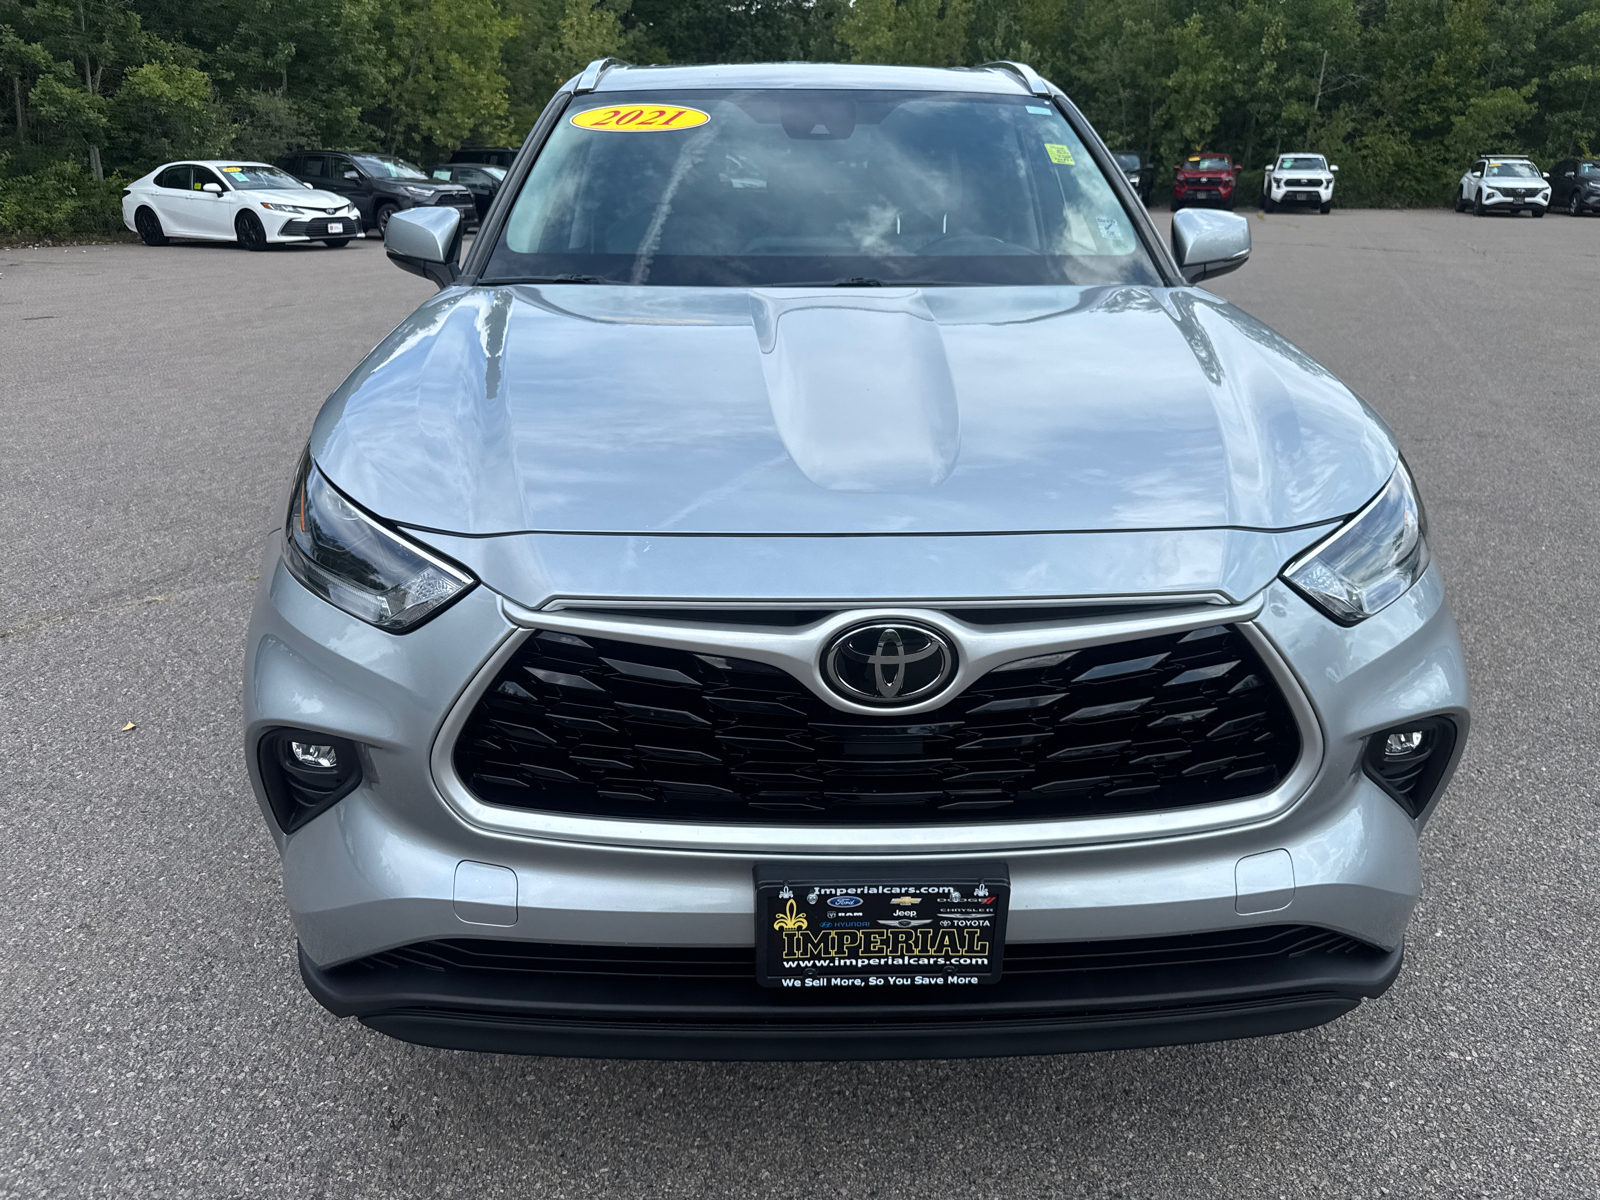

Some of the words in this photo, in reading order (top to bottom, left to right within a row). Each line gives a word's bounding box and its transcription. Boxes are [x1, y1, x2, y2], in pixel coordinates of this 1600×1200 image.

[590, 109, 687, 127] 2021
[813, 886, 954, 896] Imperialcars.com
[835, 898, 855, 906] Ford
[893, 909, 917, 918] Jeep
[783, 928, 989, 959] IMPERIAL
[783, 956, 988, 968] www.imperialcars.com
[781, 978, 802, 987] We
[804, 977, 827, 987] Sell
[831, 977, 865, 987] More,
[868, 976, 885, 986] So
[888, 976, 911, 985] You
[914, 975, 944, 985] Save
[947, 975, 979, 985] More
